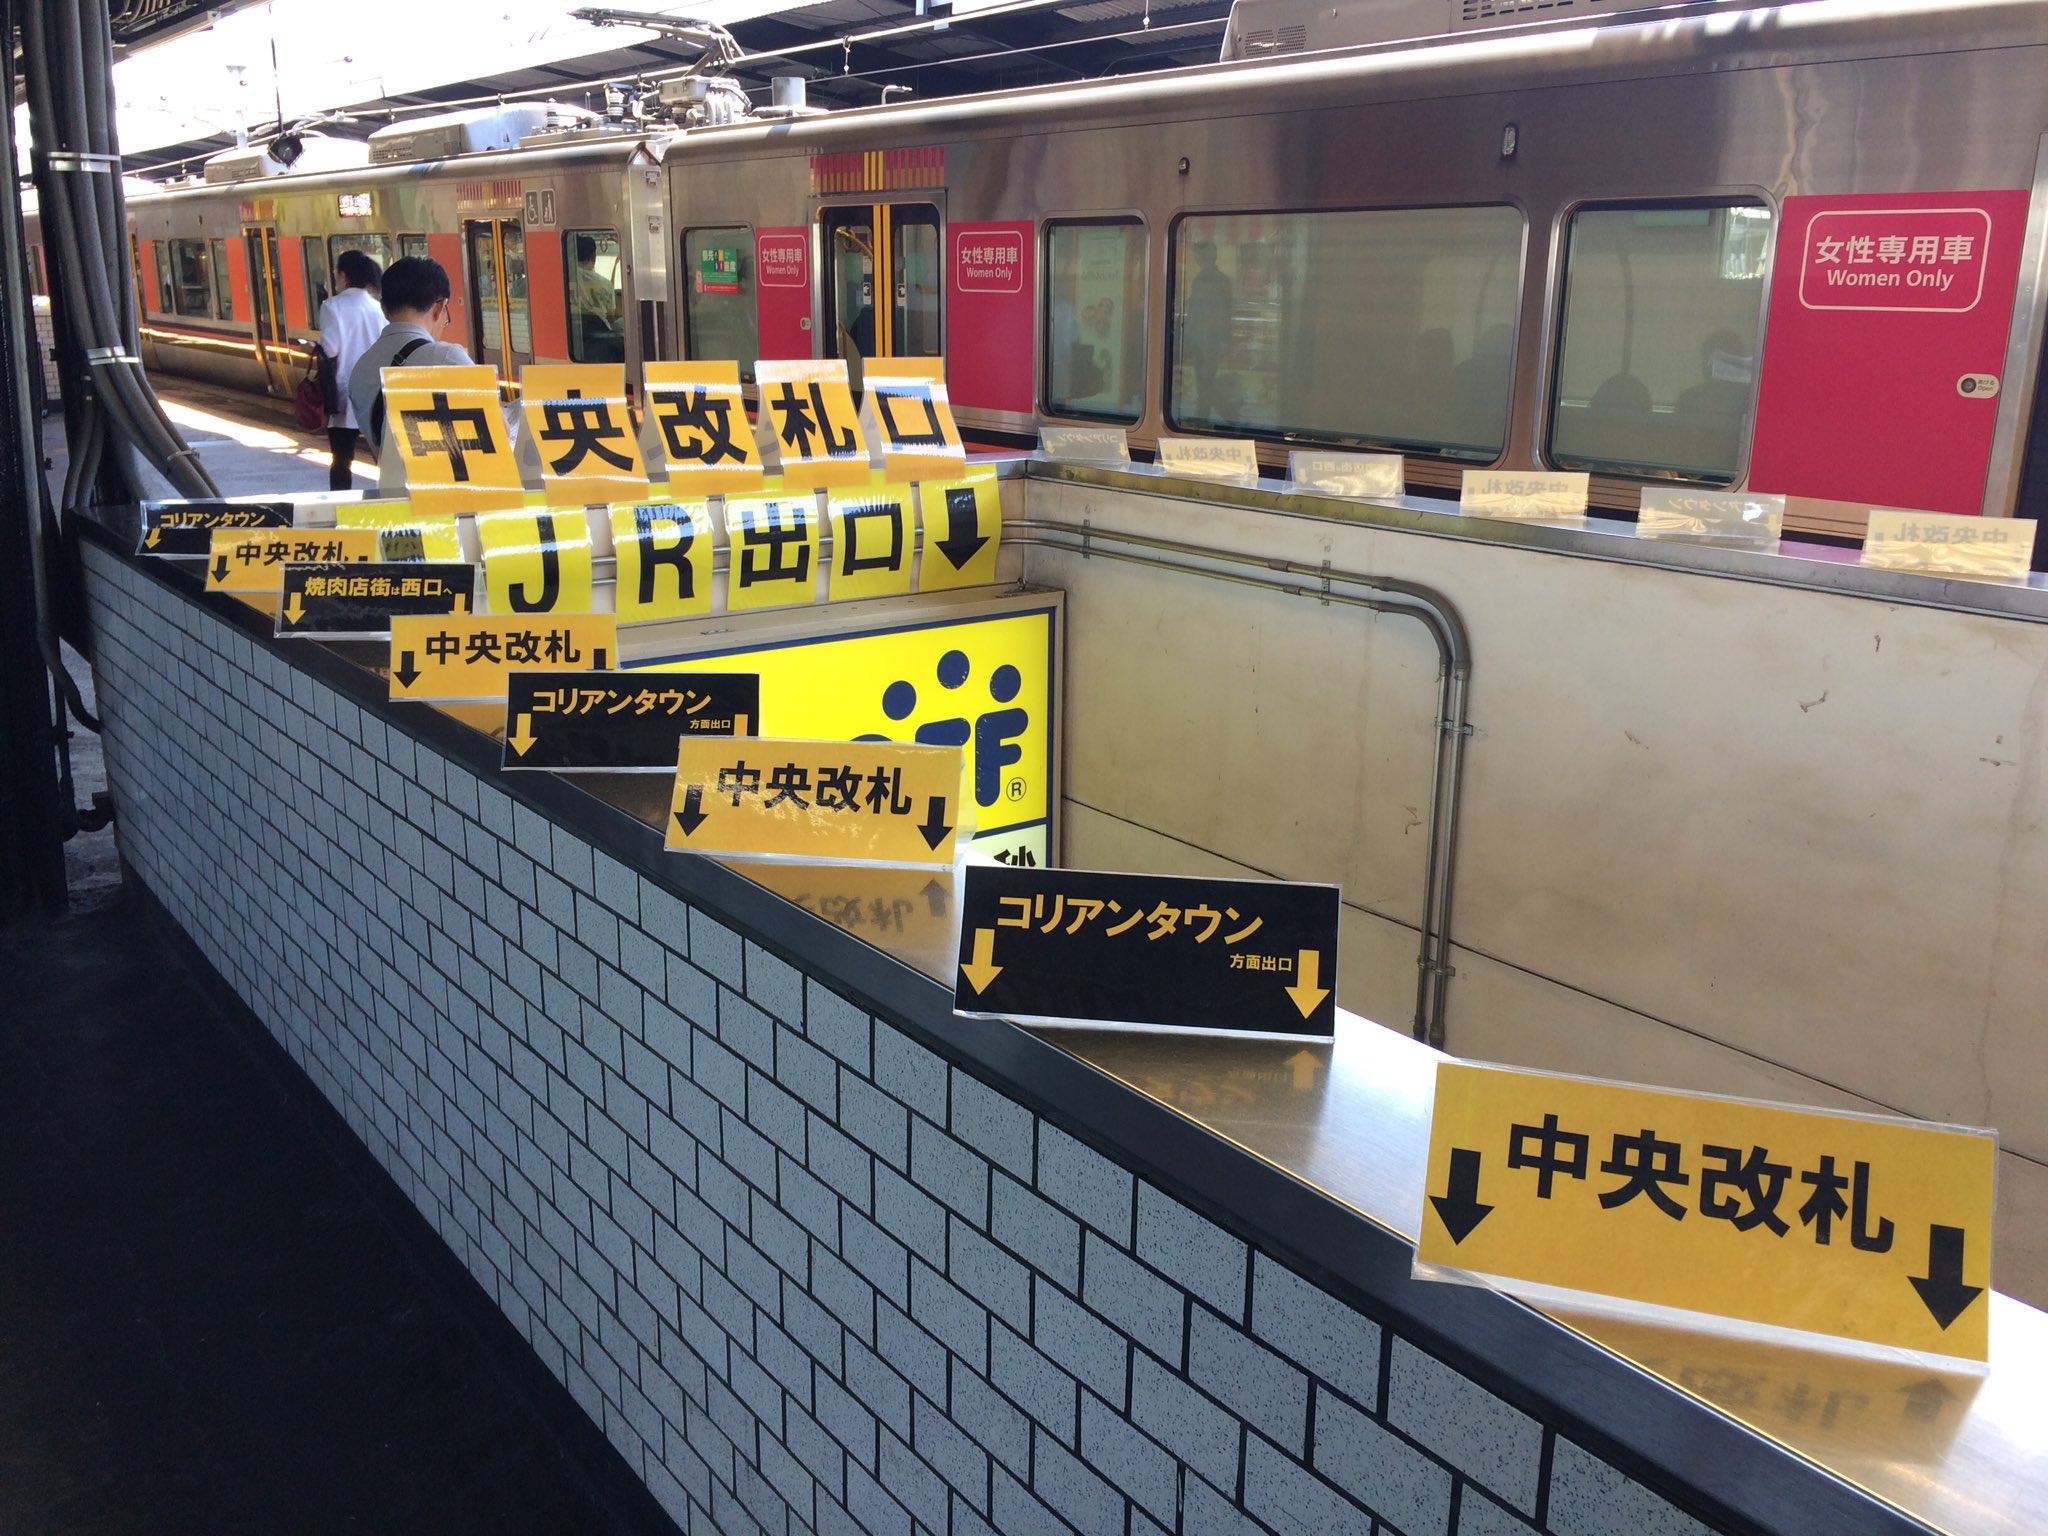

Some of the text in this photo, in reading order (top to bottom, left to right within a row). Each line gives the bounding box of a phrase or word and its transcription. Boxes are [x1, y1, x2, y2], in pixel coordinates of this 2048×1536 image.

[762, 248, 803, 263] 女性専用車
[961, 246, 1018, 265] 女性専用車
[1815, 235, 1975, 265] 女性専用車
[766, 265, 799, 278] Women Only
[966, 266, 1013, 281] Women Only
[1826, 269, 1954, 292] Women Only
[160, 511, 265, 528] コリアンタウン
[235, 541, 348, 567] 中央改札
[305, 576, 452, 597] 焼肉店街は西口へ
[425, 630, 581, 666] 中央改札
[532, 688, 712, 715] コリアンタウン
[690, 719, 731, 729] 方面出口
[717, 760, 912, 815] 中央改札
[997, 894, 1264, 945] コリアンタウン
[1229, 953, 1293, 973] 方面出口
[1506, 1113, 1895, 1254] 中央改札
